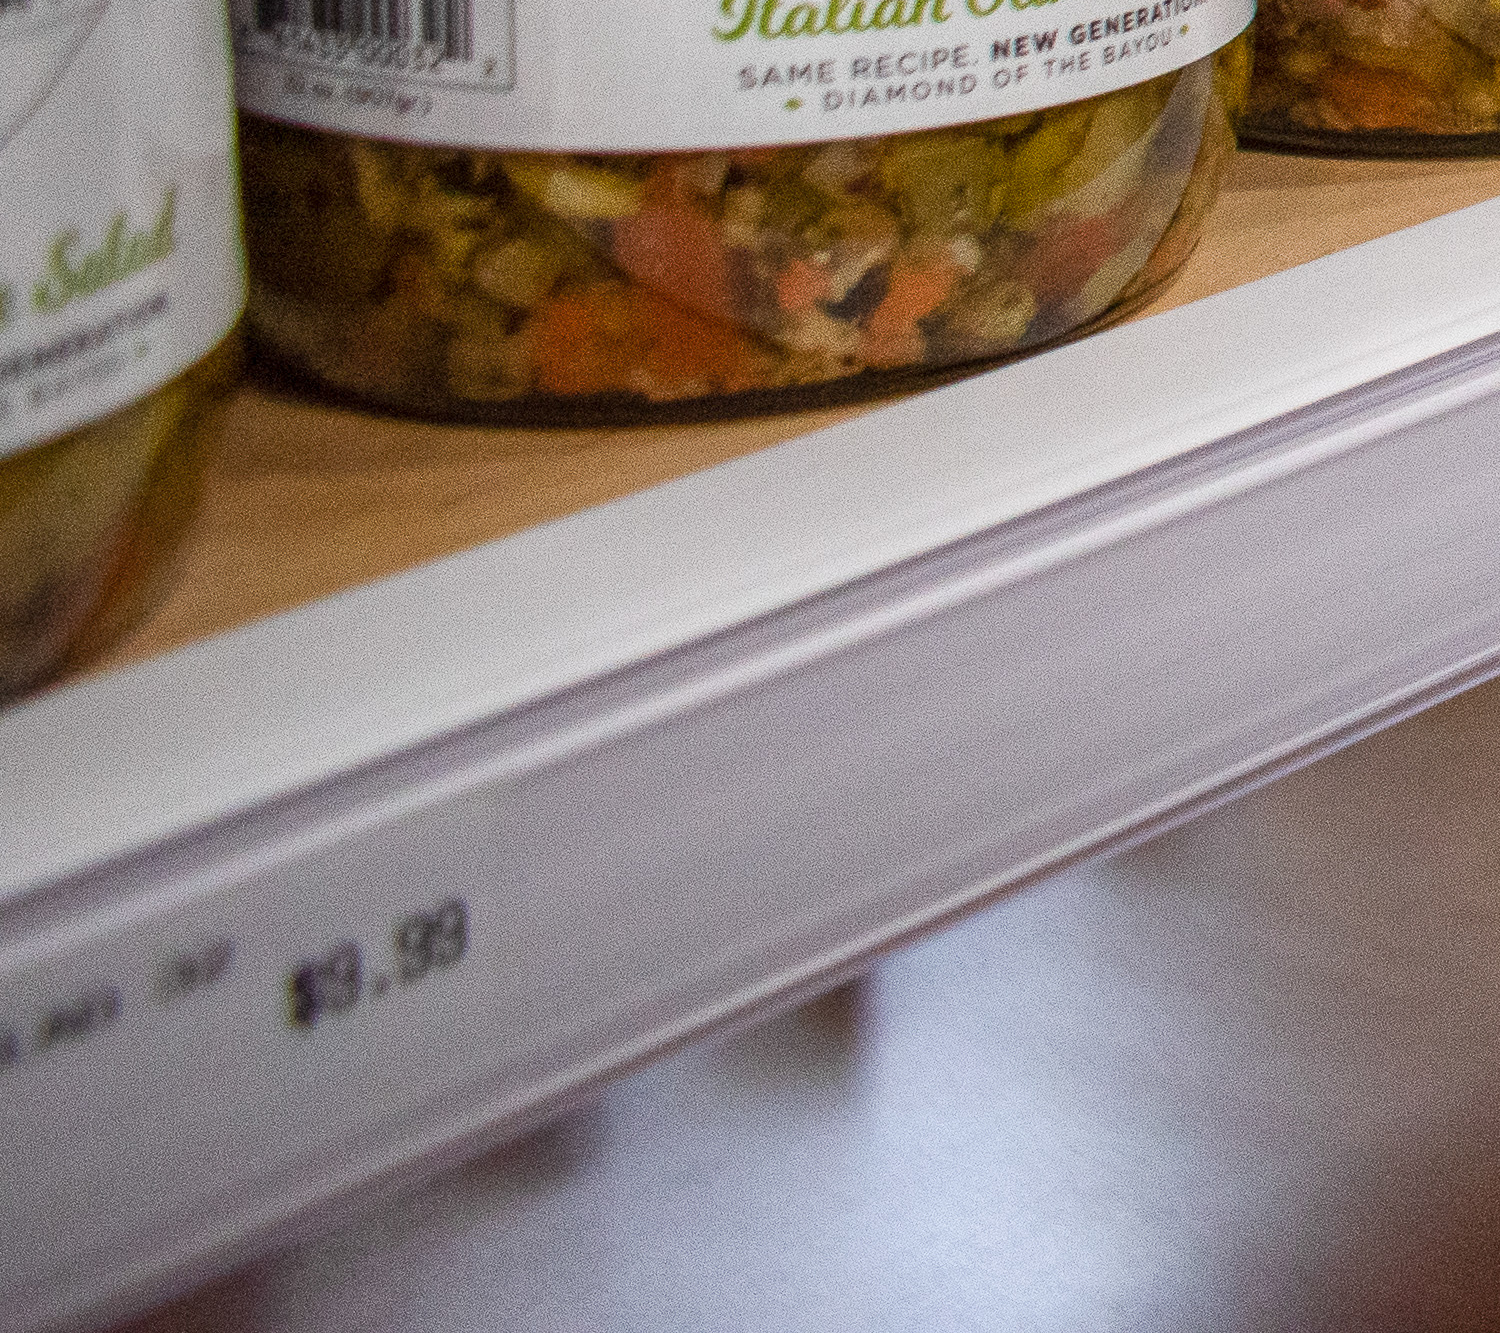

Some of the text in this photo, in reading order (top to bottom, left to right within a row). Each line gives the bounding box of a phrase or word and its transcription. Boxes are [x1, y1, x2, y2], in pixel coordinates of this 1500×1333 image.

[735, 58, 838, 95] SAME
[988, 25, 1060, 62] NEW
[820, 73, 978, 115] DIAMOND
[992, 62, 1033, 93] OF
[1041, 47, 1092, 81] THE
